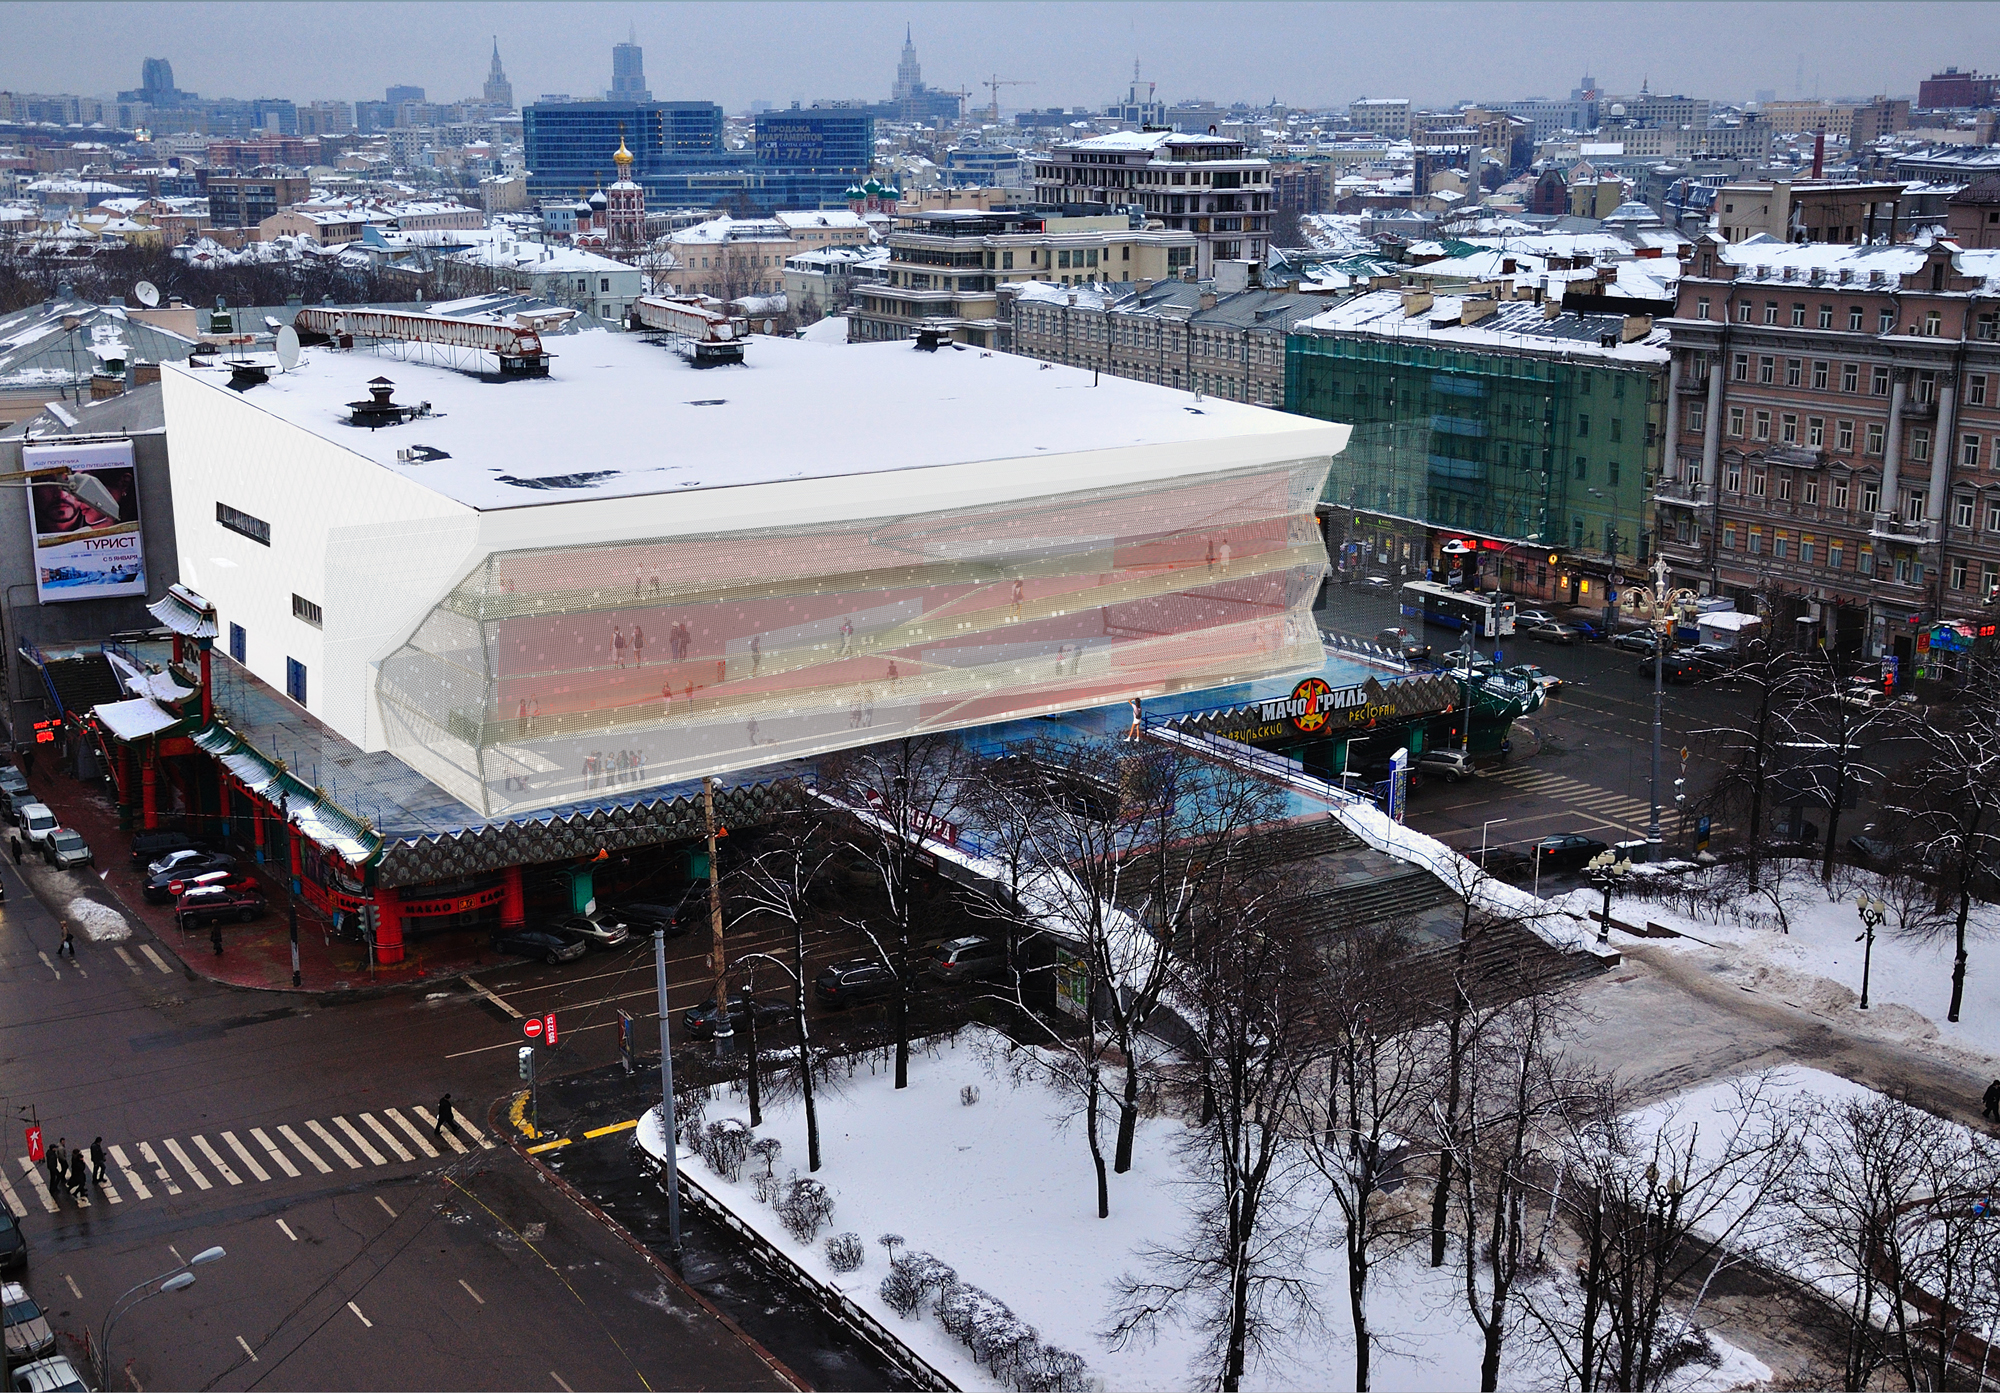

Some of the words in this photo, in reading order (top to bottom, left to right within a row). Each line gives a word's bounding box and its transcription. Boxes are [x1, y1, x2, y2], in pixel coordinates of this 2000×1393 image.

[757, 133, 823, 142] АПАРТАМЕНТОВ
[757, 148, 823, 159] 771-77-77
[83, 537, 137, 550] ТУРИСТ
[1261, 697, 1308, 722] МАЧО
[1315, 688, 1368, 714] ГРИЛЬ
[1348, 702, 1396, 721] РЕСТОРАН
[405, 903, 451, 914] МАКАО
